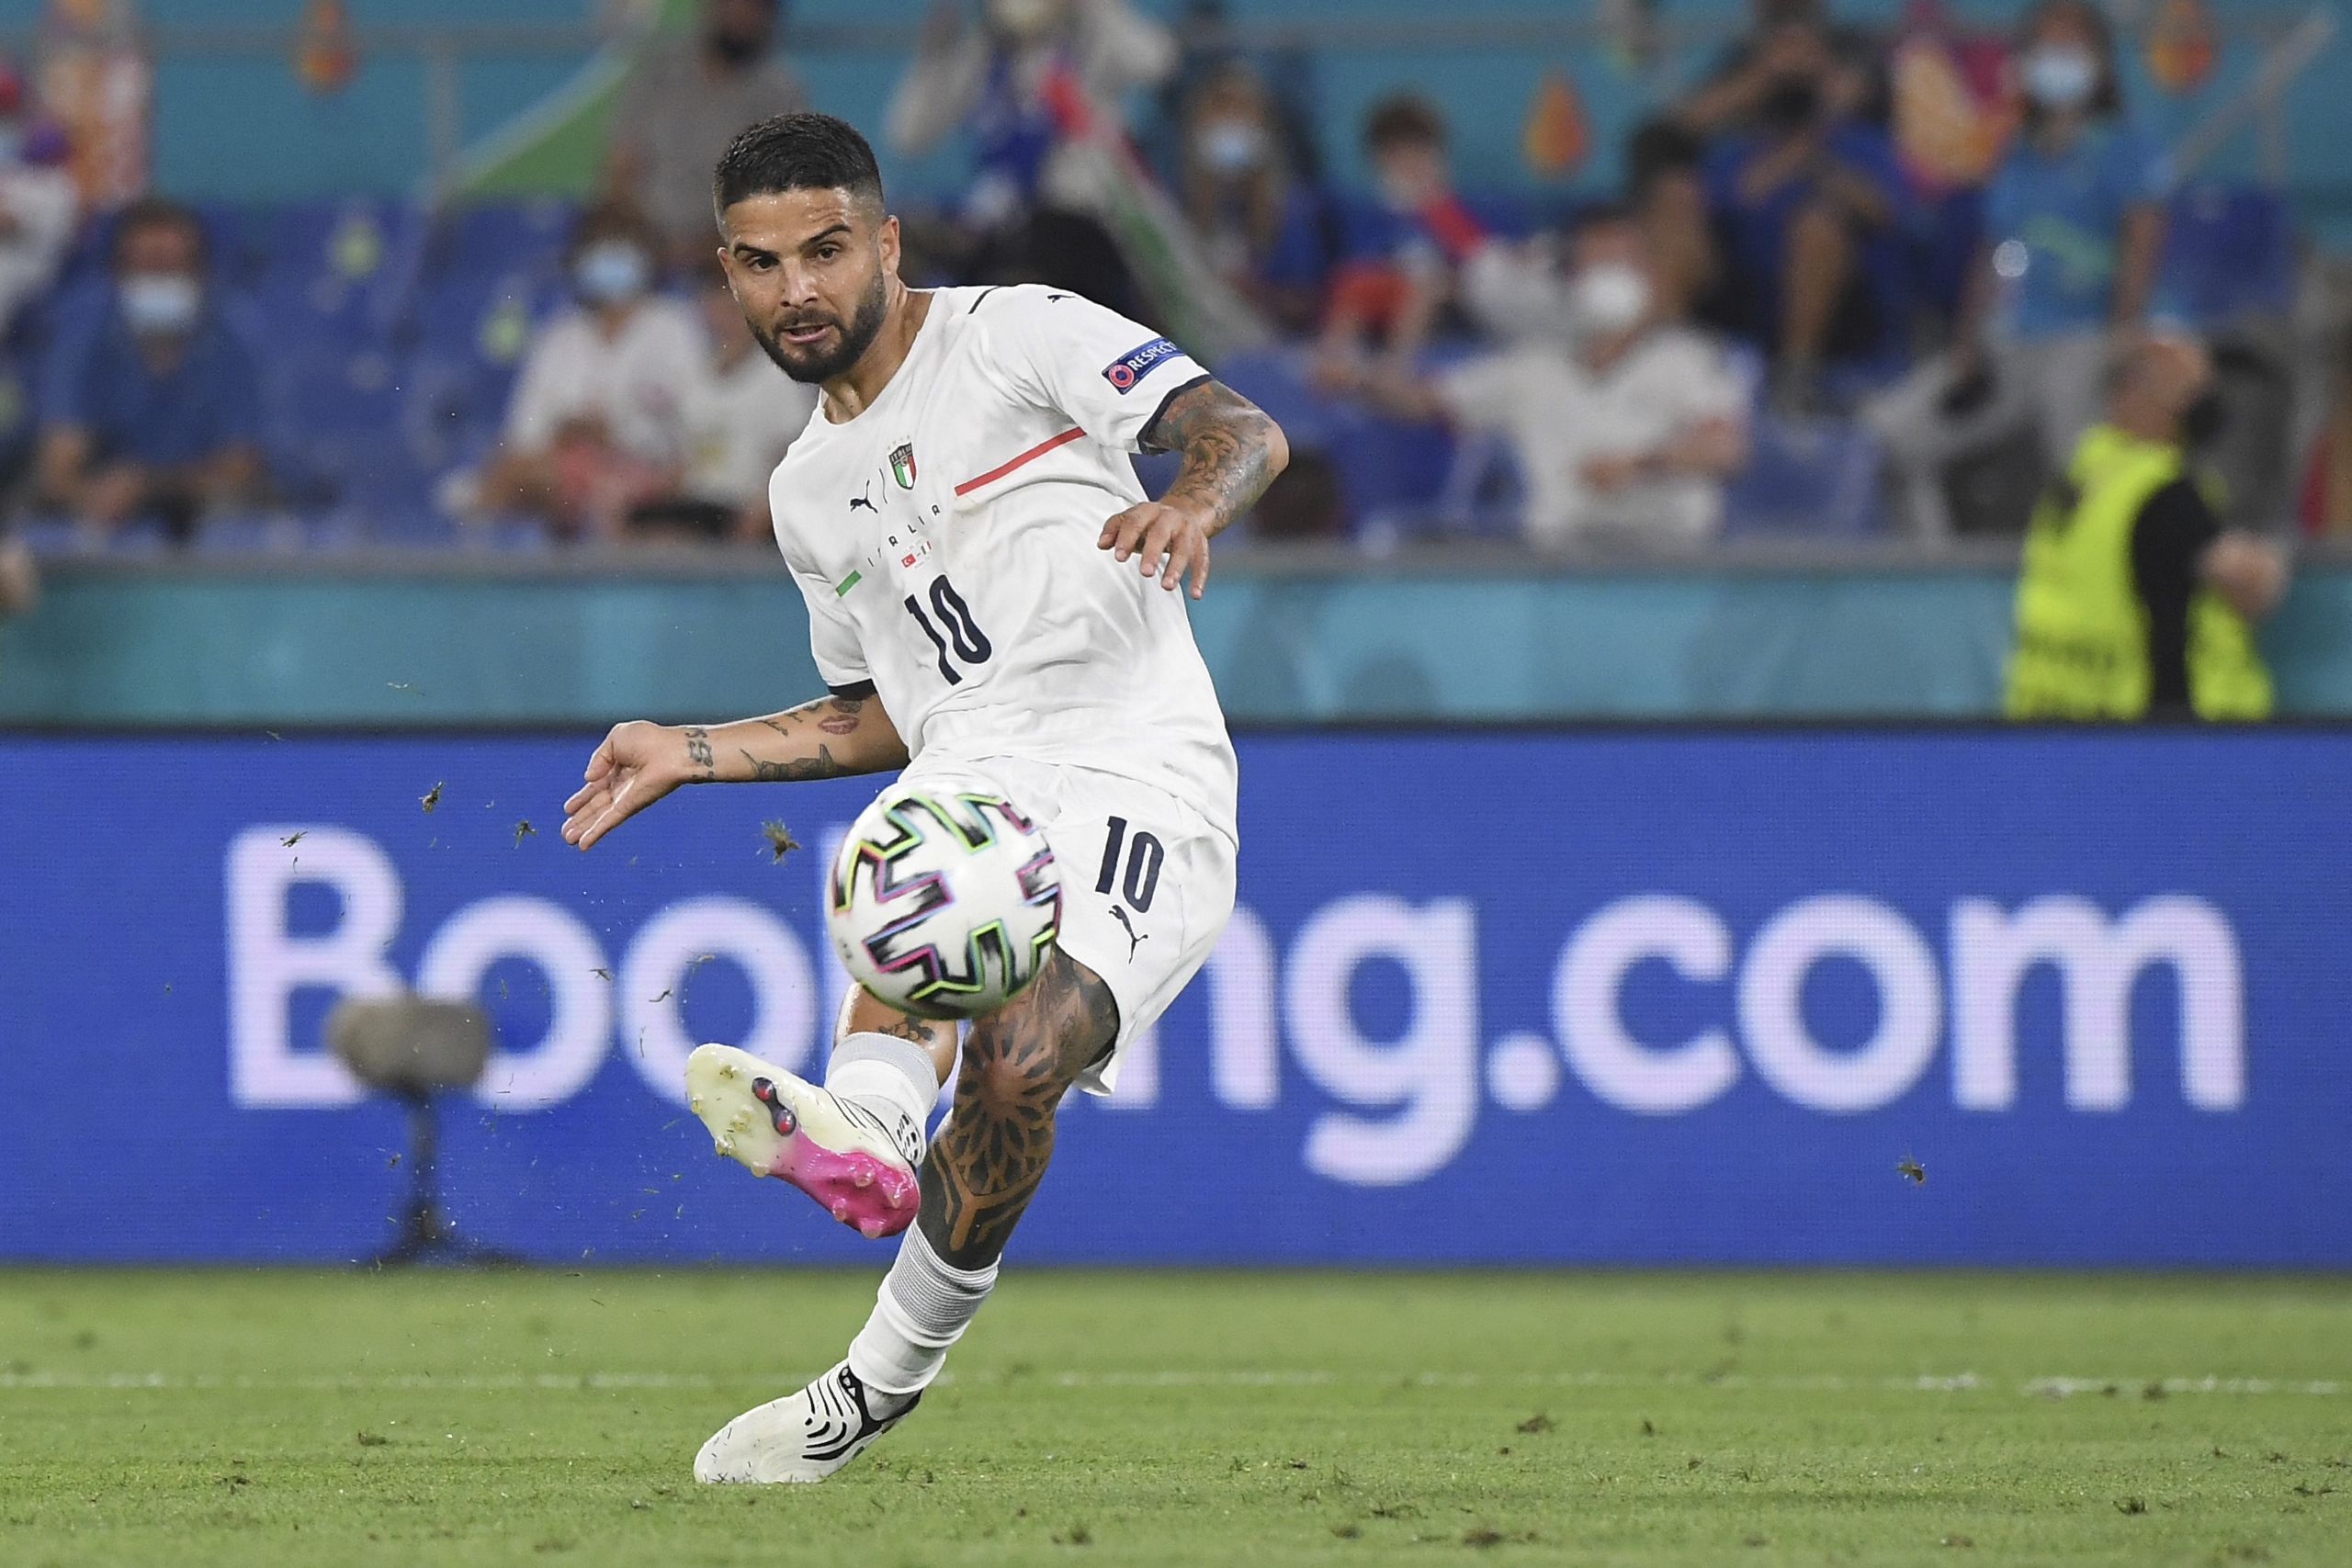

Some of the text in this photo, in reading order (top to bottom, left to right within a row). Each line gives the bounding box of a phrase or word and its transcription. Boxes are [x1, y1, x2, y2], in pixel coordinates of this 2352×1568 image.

[1127, 340, 1177, 370] RESPECT
[904, 574, 992, 686] 10
[1094, 816, 1164, 913] 10
[223, 823, 2245, 1185] Boong.com
